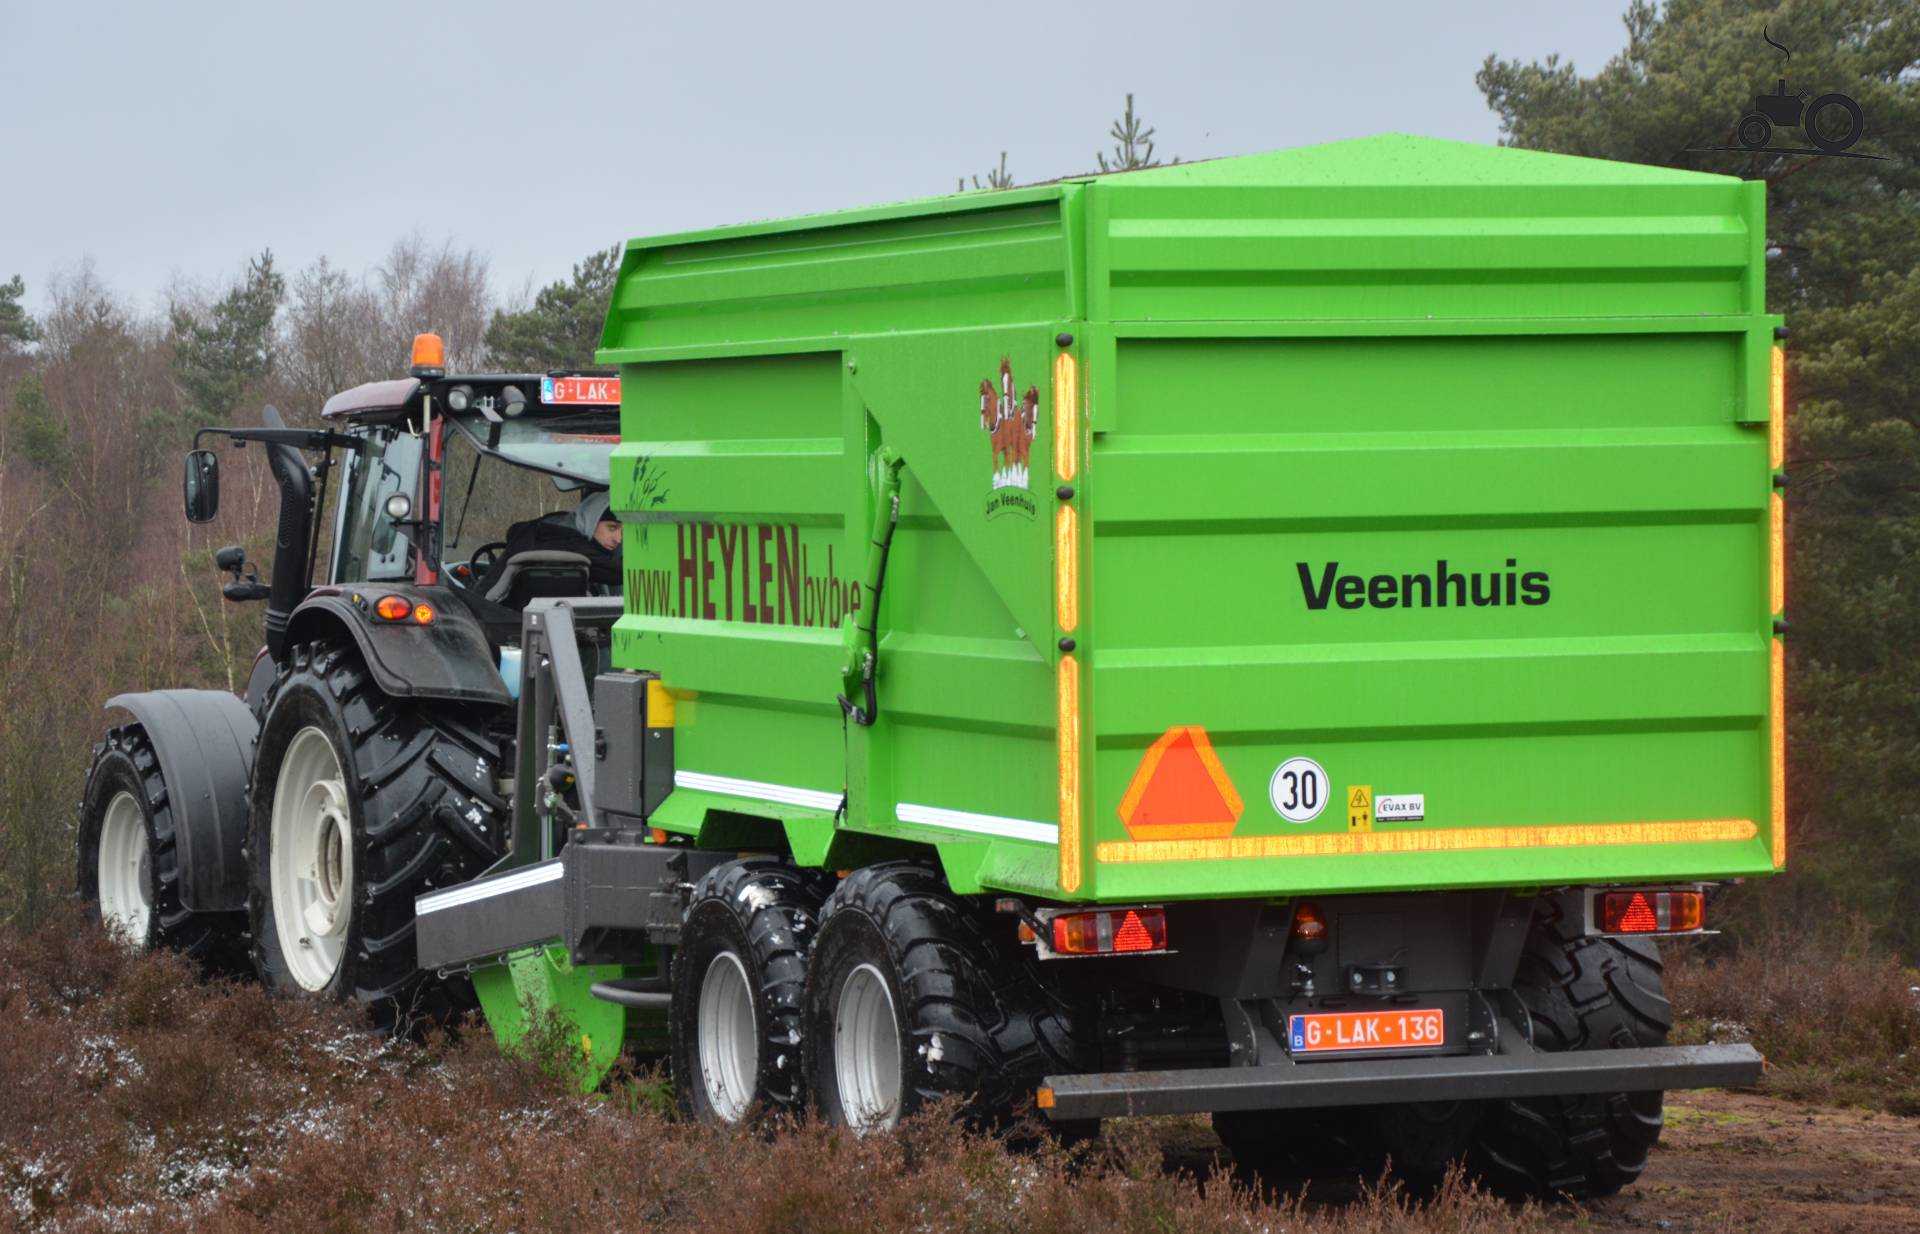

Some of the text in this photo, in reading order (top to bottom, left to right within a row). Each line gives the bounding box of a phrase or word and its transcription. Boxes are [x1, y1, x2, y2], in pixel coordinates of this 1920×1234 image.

[1000, 492, 1036, 515] Veenhuis
[1296, 558, 1551, 610] Veenhuis
[1282, 770, 1317, 810] 30
[1383, 802, 1422, 812] EVAX BV
[1294, 1035, 1304, 1047] B
